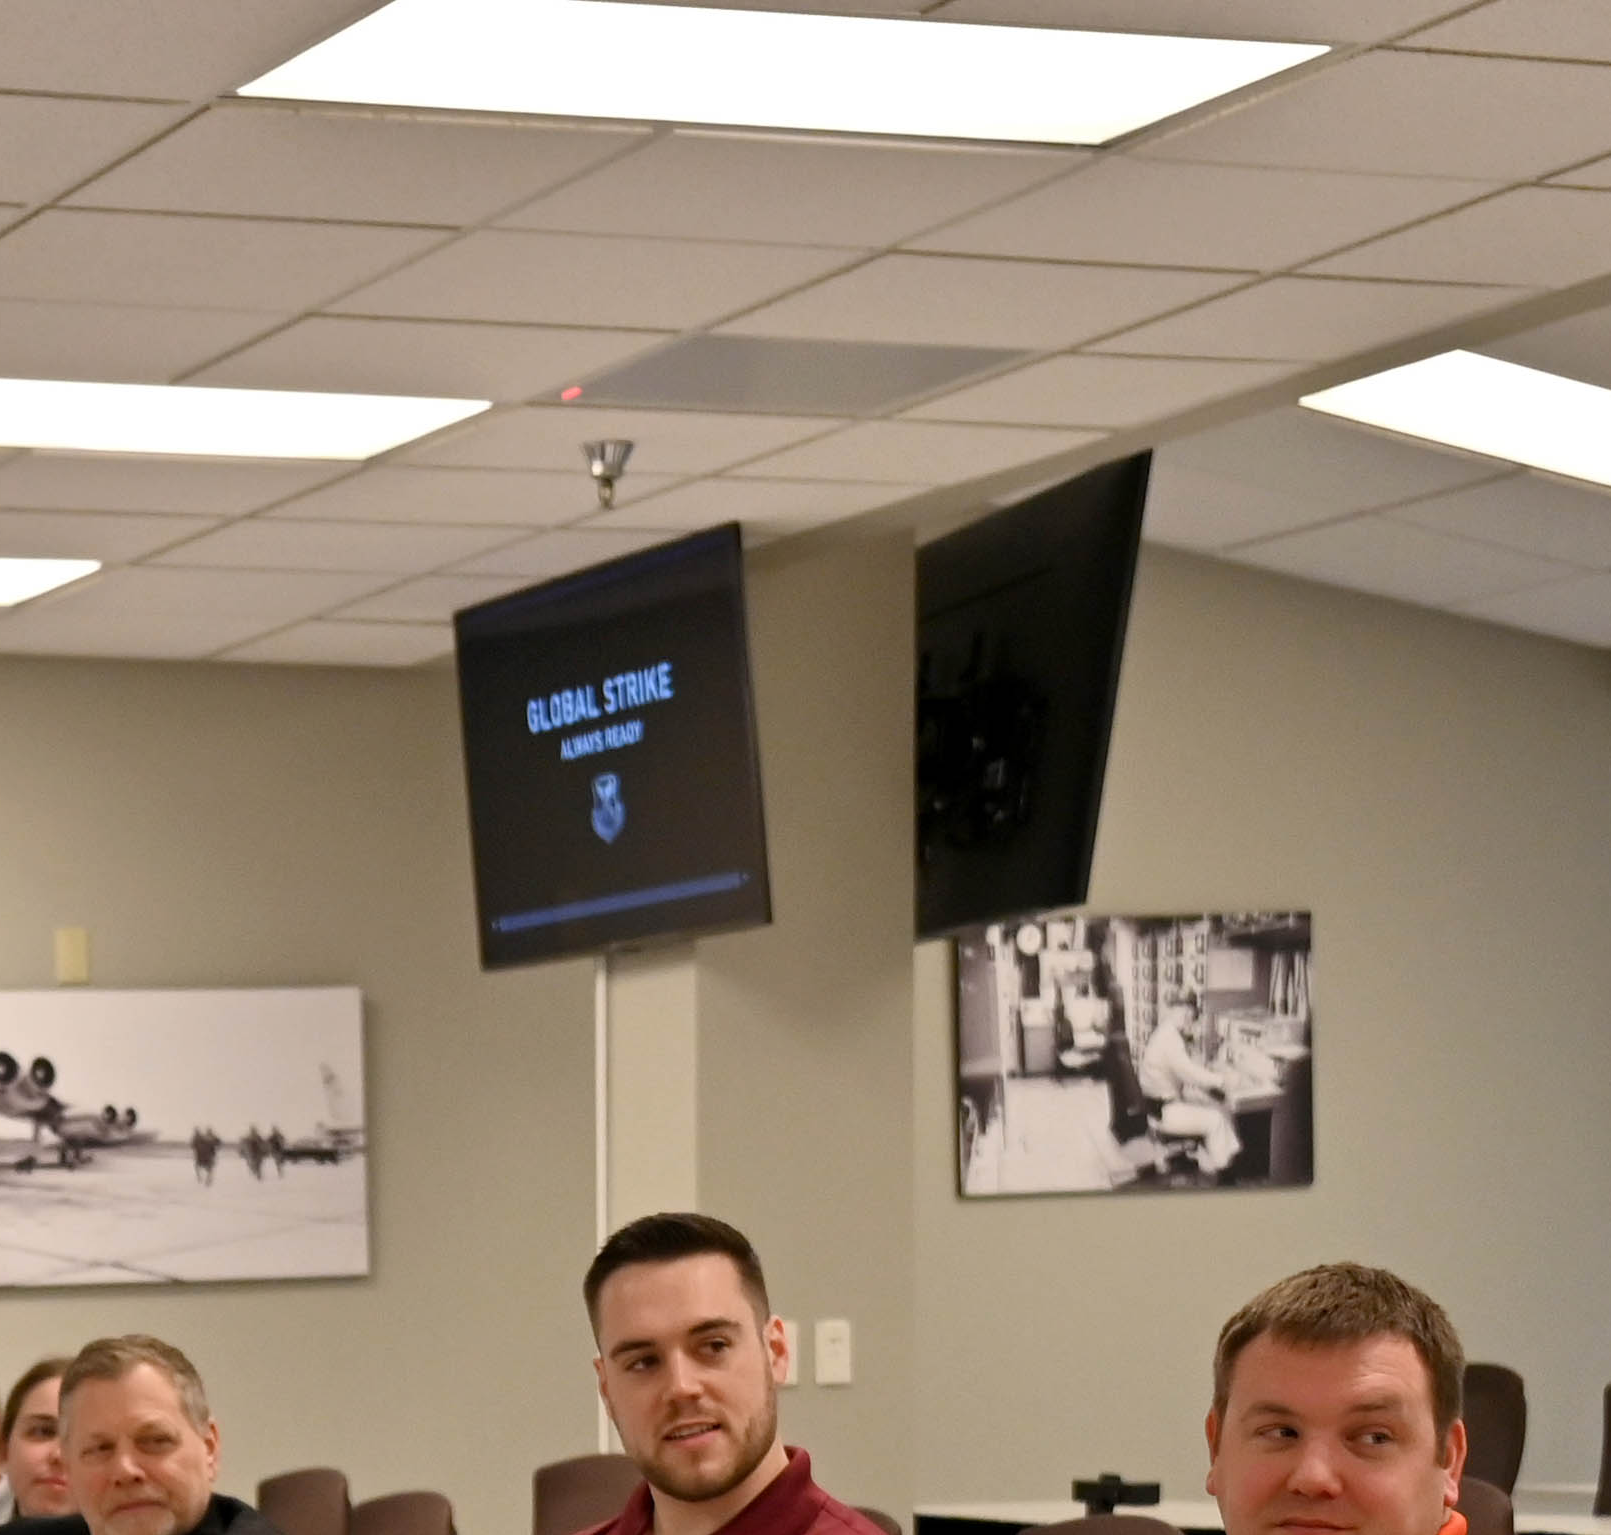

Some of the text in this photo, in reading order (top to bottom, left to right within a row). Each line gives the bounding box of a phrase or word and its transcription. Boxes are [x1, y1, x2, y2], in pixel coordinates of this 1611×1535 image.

[527, 660, 675, 735] GLOBAL STRIKE
[559, 718, 645, 761] ALWAYS READY
